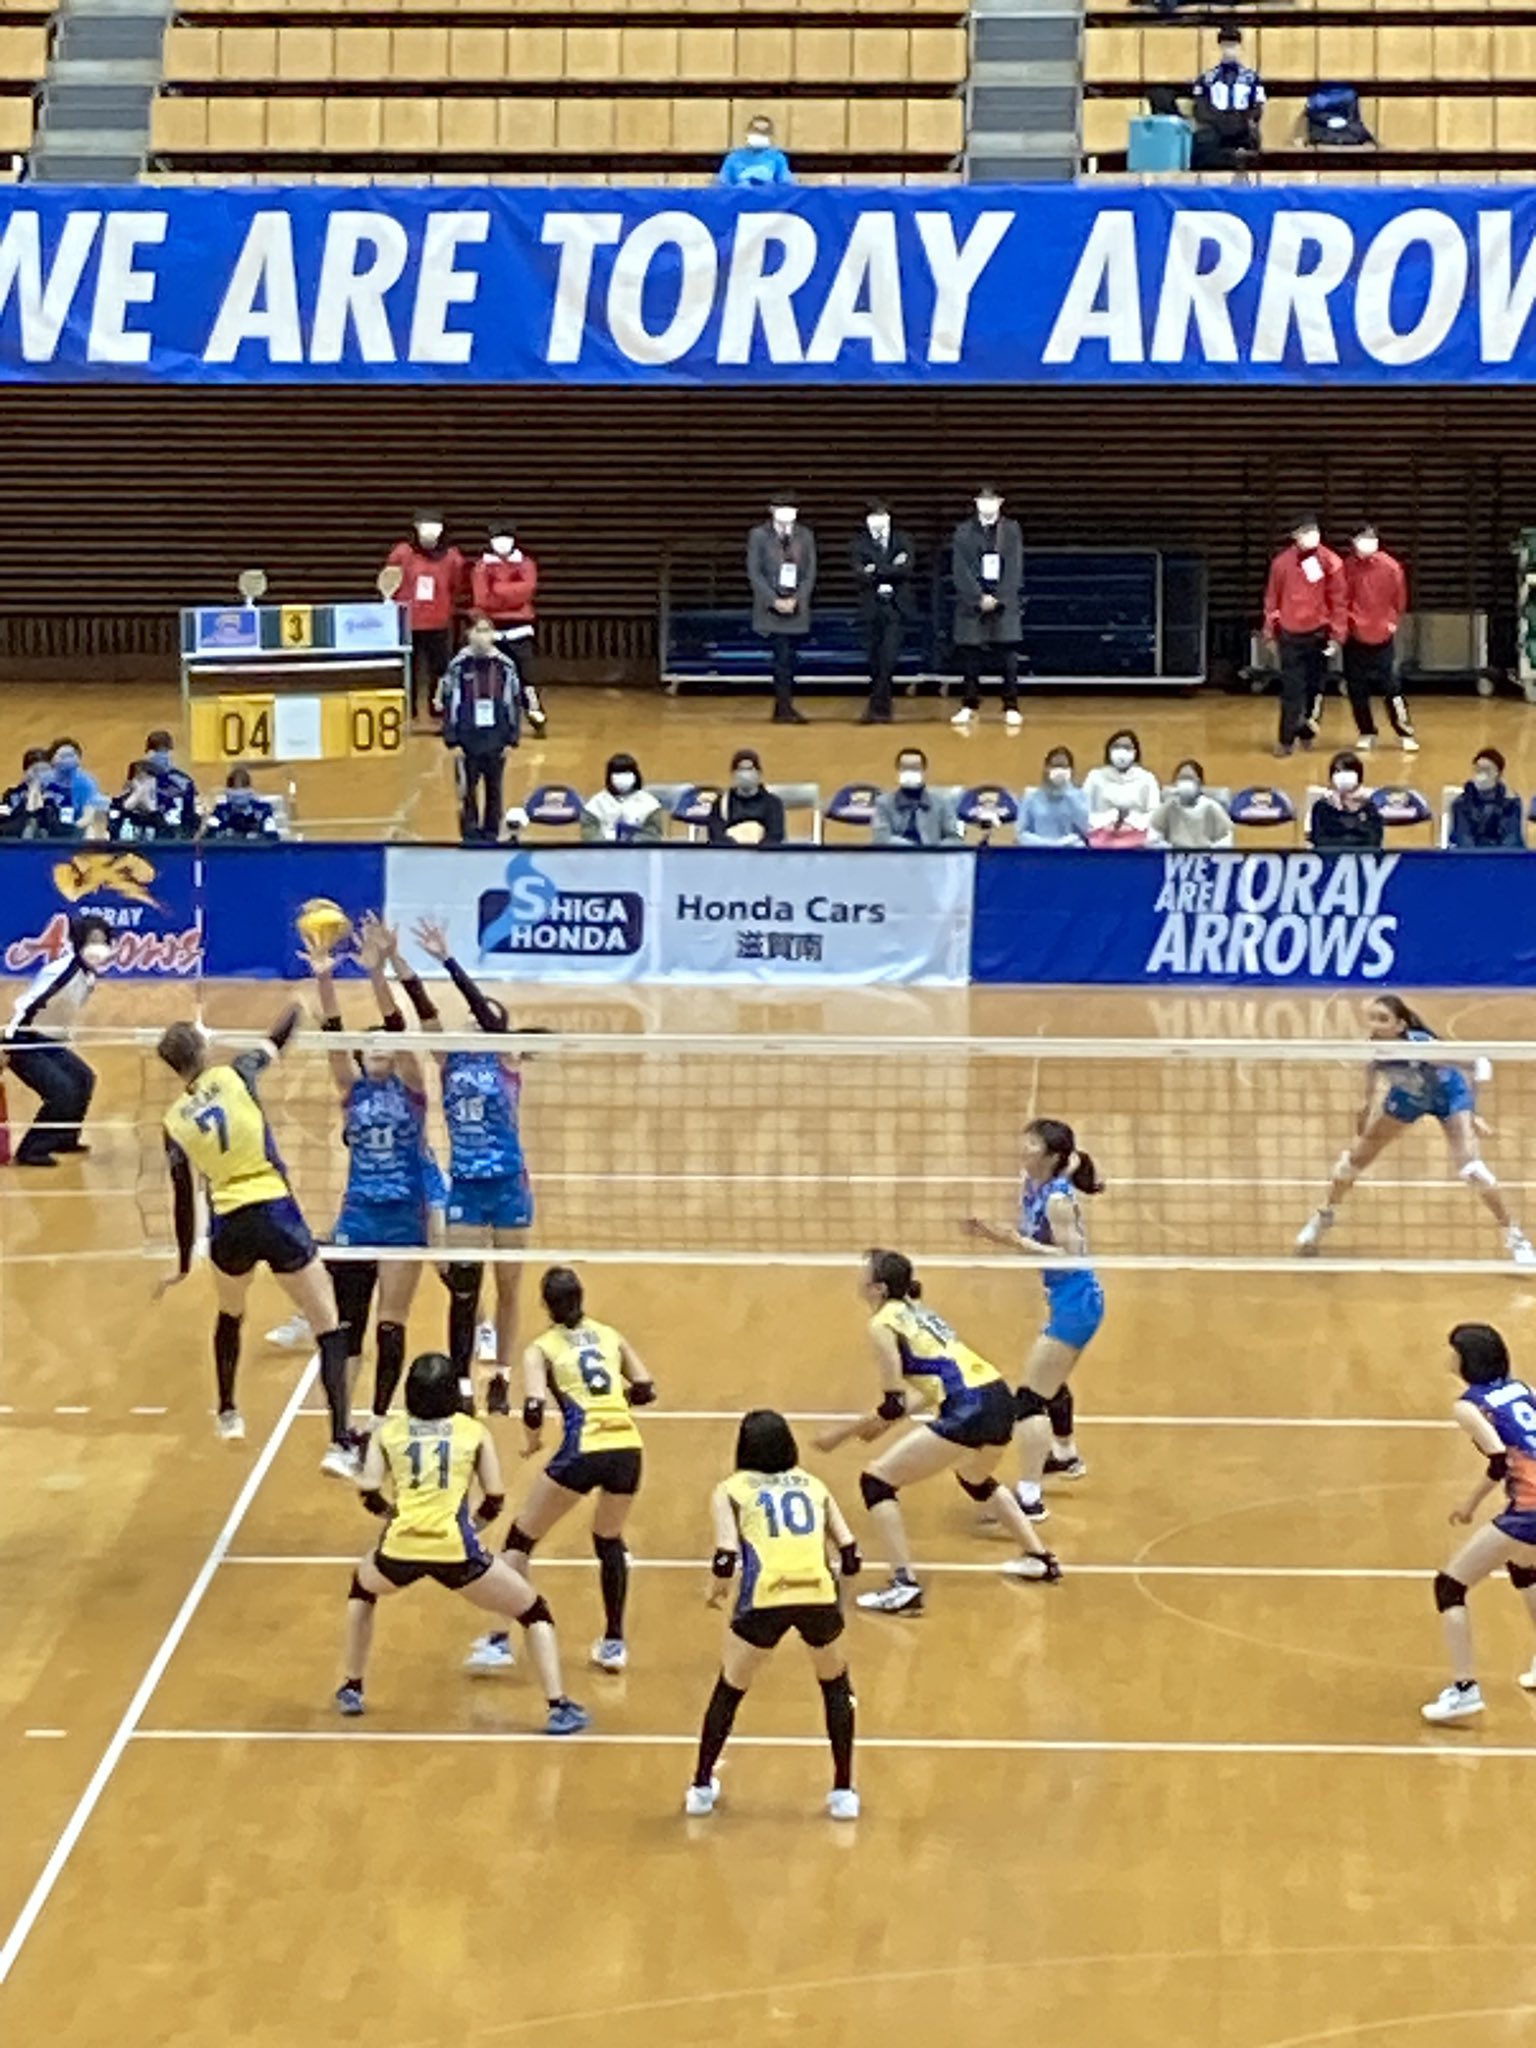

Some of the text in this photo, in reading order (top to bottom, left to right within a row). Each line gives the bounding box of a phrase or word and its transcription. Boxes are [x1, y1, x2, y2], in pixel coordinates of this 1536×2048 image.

[0, 210, 169, 362] WE
[203, 210, 490, 363] ARE
[541, 210, 1015, 365] TORAY
[287, 613, 304, 643] 3
[222, 711, 270, 755] 04
[352, 706, 401, 751] 08
[1164, 853, 1213, 882] WE
[1210, 853, 1400, 916] TORAY
[512, 875, 629, 924] SHIGA
[676, 894, 886, 924] Honda Cars
[1153, 881, 1214, 914] ARE
[510, 924, 627, 951] HONDA
[1145, 911, 1398, 979] ARROWS
[194, 1105, 230, 1154] 7
[578, 1349, 612, 1396] 6
[404, 1440, 450, 1489] 11
[756, 1490, 815, 1537] 10
